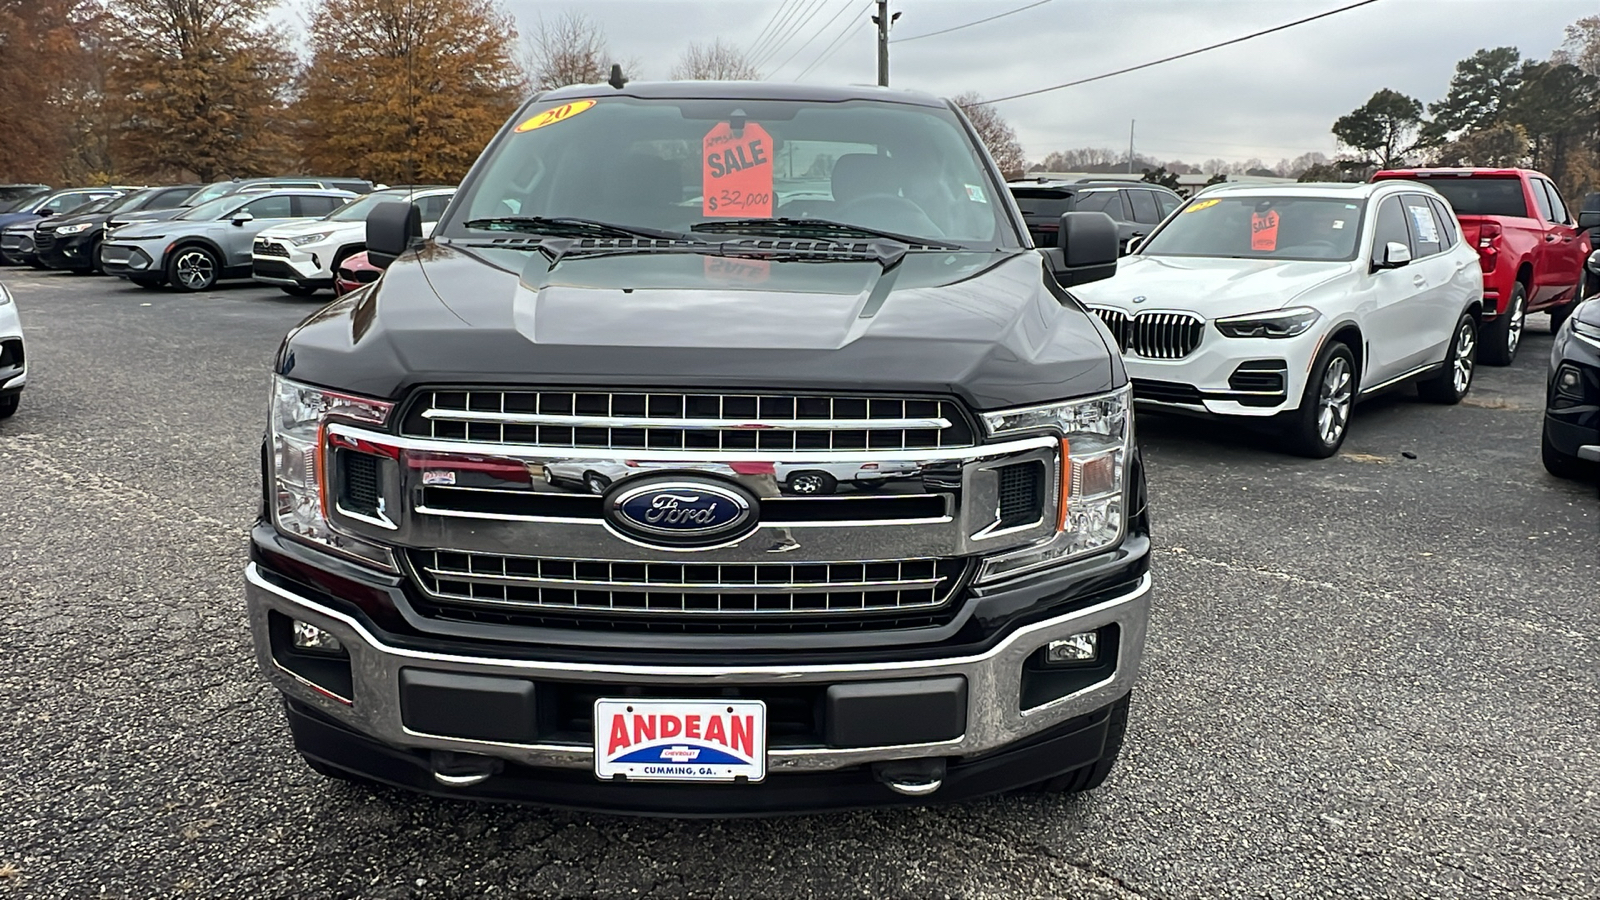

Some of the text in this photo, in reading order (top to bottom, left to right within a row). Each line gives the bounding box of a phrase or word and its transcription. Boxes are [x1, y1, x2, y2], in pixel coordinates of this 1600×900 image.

[538, 104, 572, 126] 20
[707, 139, 767, 178] SALE
[720, 189, 769, 209] 32,000
[1252, 216, 1276, 234] SALE
[645, 494, 718, 524] Ford
[607, 714, 754, 758] ANDEAN
[644, 766, 717, 776] CUMMING, GA.
